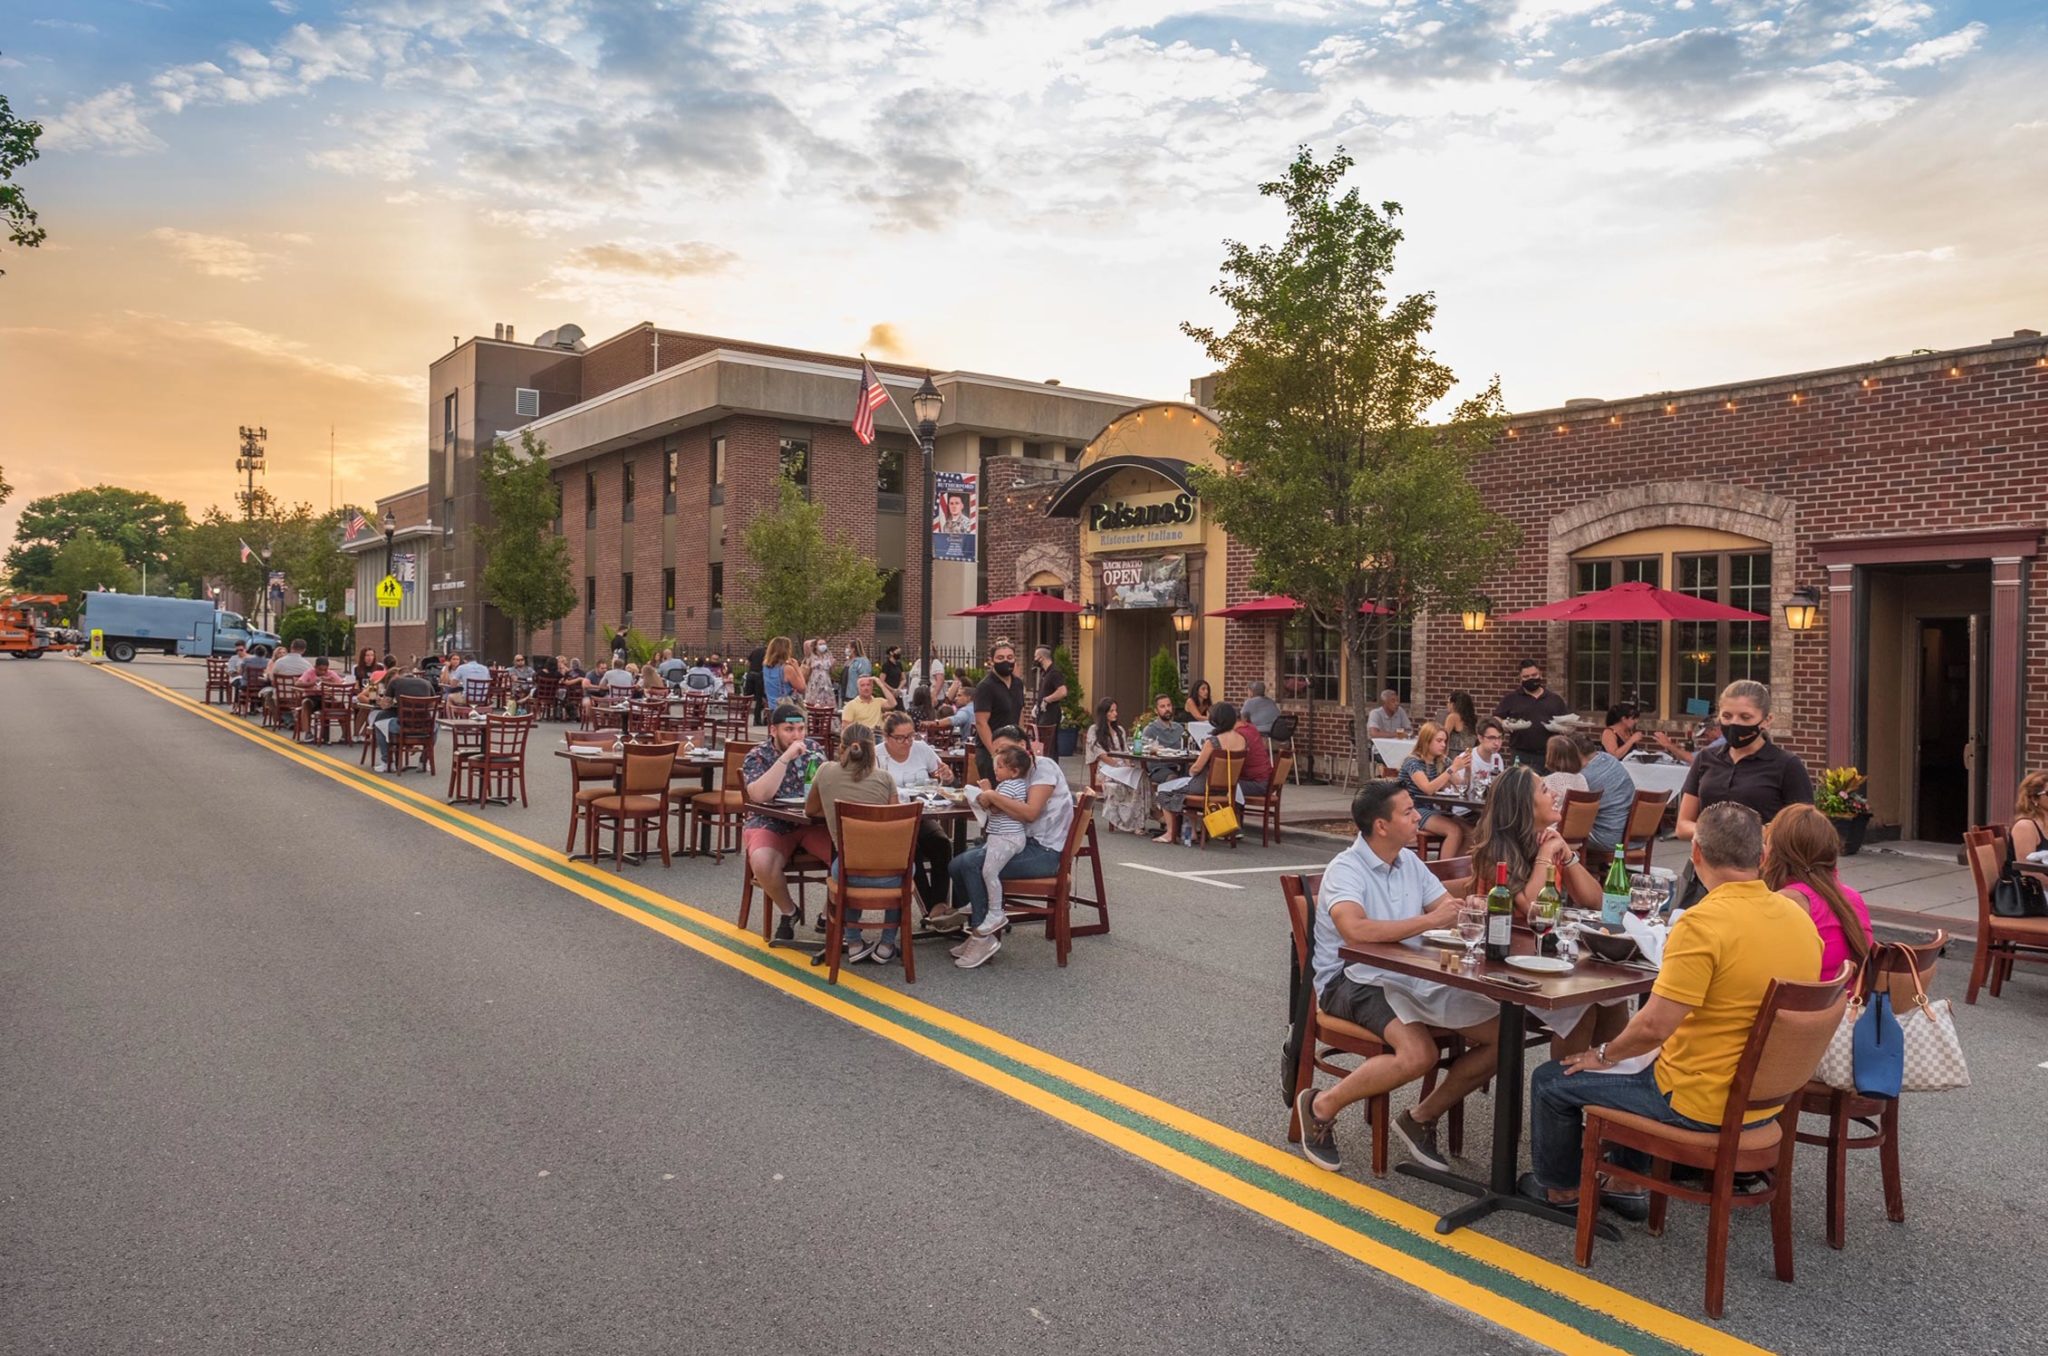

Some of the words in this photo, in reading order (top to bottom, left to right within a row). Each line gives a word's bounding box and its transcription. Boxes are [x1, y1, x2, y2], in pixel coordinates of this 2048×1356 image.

[1101, 533, 1145, 545] Ristorante
[1147, 530, 1182, 541] Italiano
[1103, 561, 1122, 570] BACK
[1122, 560, 1143, 569] PATIO
[1103, 568, 1142, 586] OPEN
